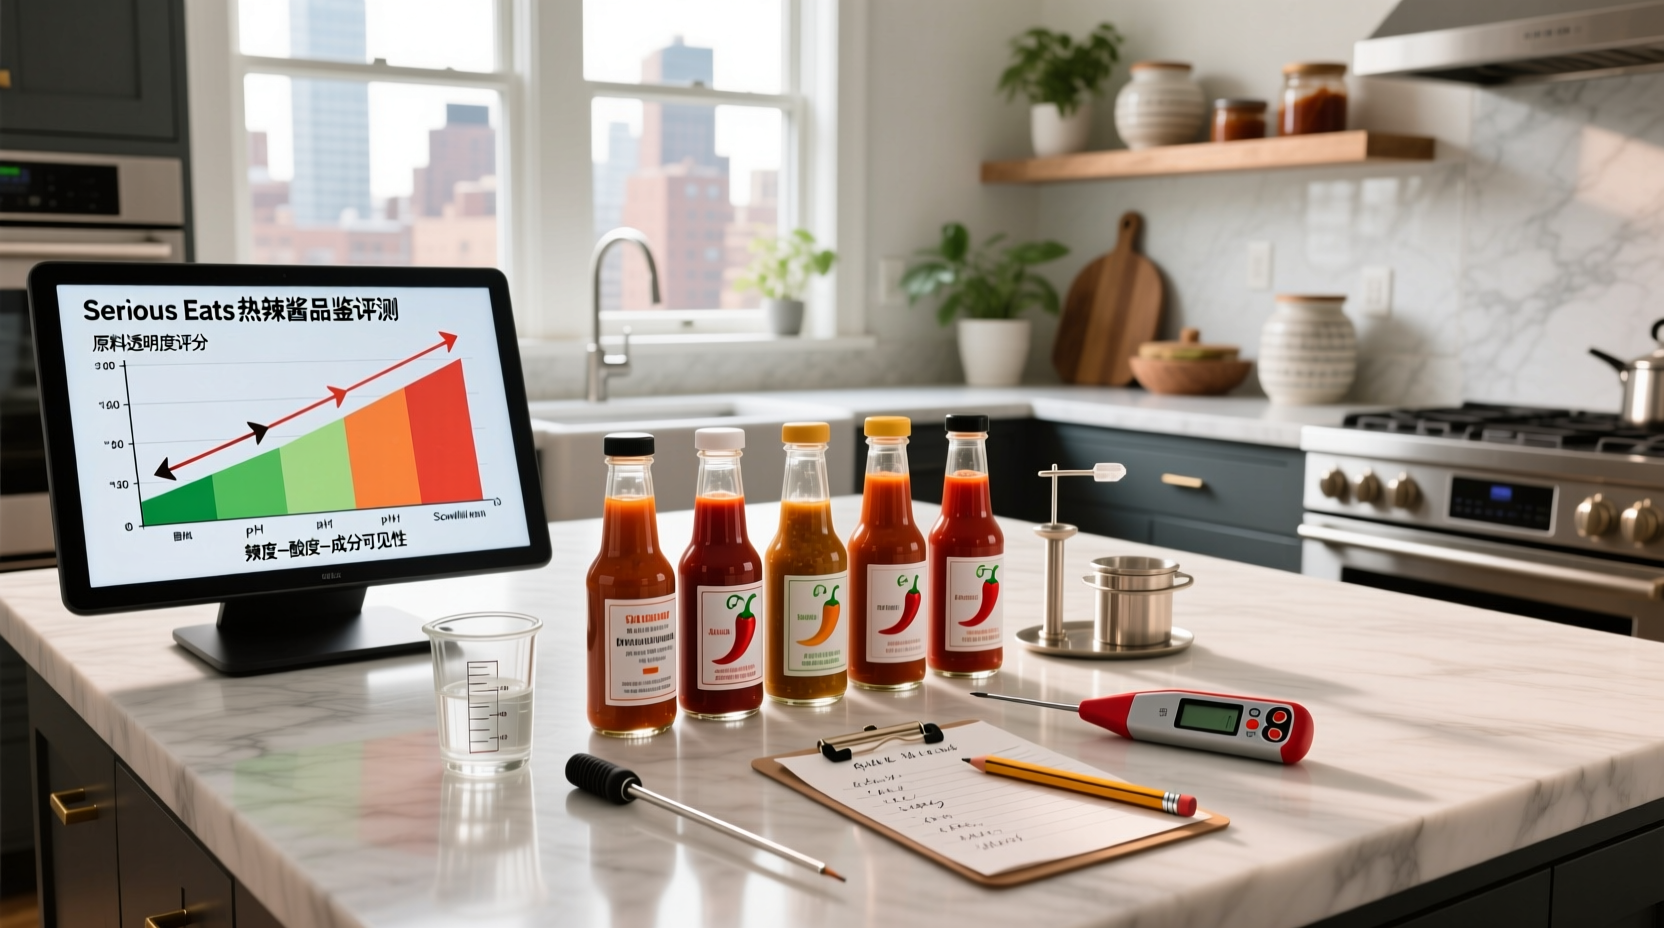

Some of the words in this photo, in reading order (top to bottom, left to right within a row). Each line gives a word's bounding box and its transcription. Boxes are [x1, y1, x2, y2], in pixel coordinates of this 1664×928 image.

[83, 298, 178, 321] Serious
[92, 333, 209, 353] 原料透明度评分
[246, 524, 264, 539] pH
